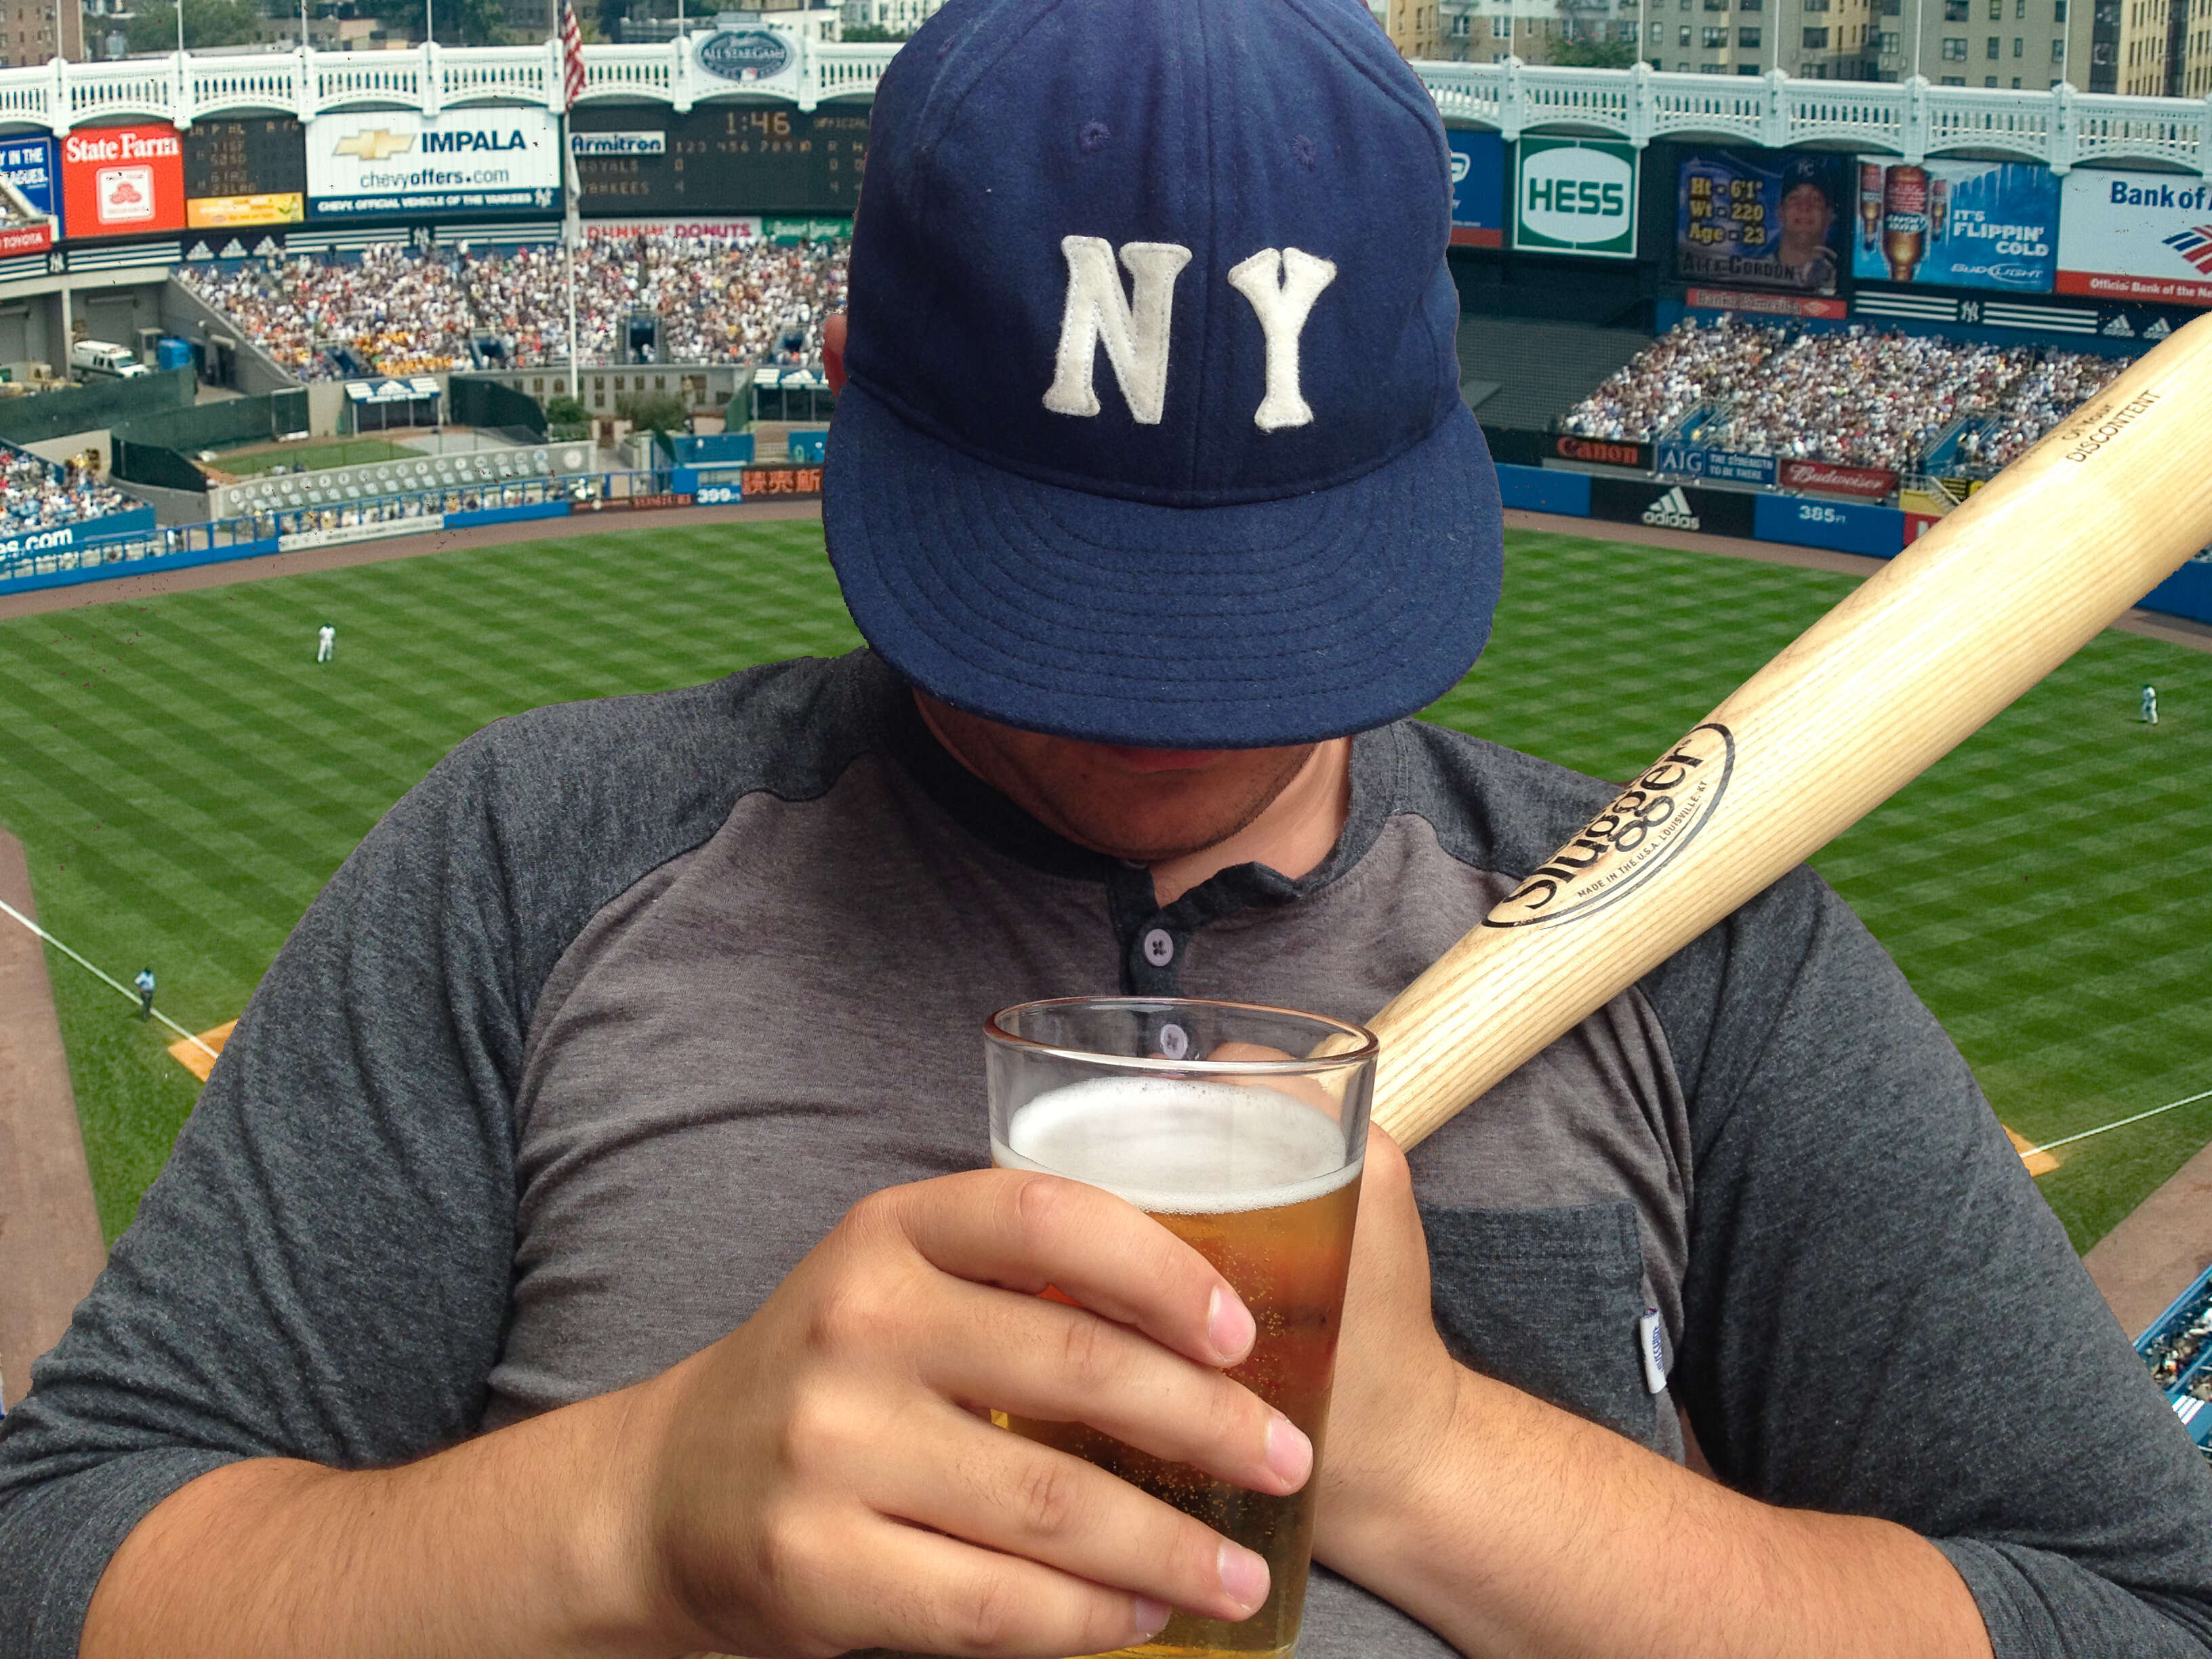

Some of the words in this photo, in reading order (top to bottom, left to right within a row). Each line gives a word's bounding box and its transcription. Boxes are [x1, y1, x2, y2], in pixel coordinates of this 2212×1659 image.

[726, 111, 791, 134] 1:46
[66, 136, 119, 163] State
[120, 132, 179, 159] Farm
[422, 129, 527, 153] IMPALA
[571, 135, 662, 152] Armitron
[360, 168, 510, 190] chevyoffers.com
[1690, 177, 1712, 197] Ht
[1529, 177, 1624, 217] HESS
[2110, 180, 2175, 208] Bank
[2179, 186, 2207, 211] of
[1689, 199, 1713, 218] Wt
[1731, 204, 1764, 222] 220
[1953, 209, 1986, 222] IT'S
[675, 223, 751, 238] DONUTS
[1689, 222, 1725, 243] Age
[1742, 226, 1765, 244] 23
[1952, 222, 2045, 242] FLIPPIN'
[1995, 241, 2050, 257] COLD
[2089, 277, 2129, 291] Official
[2131, 281, 2160, 294] Bank
[2163, 284, 2175, 295] of
[2177, 284, 2195, 298] the
[2066, 390, 2160, 462] DISCONTENT
[1557, 436, 1639, 465] Canon
[1662, 448, 1704, 471] AIG
[1789, 464, 1885, 490] Budweiser
[1642, 510, 1700, 531] adidas
[1502, 739, 1705, 909] Slugger
[1577, 880, 1605, 898] MADE
[1605, 872, 1618, 884] IN
[1619, 858, 1637, 874] THE
[1637, 842, 1661, 861] U.S.A.
[1697, 780, 1708, 792] KY
